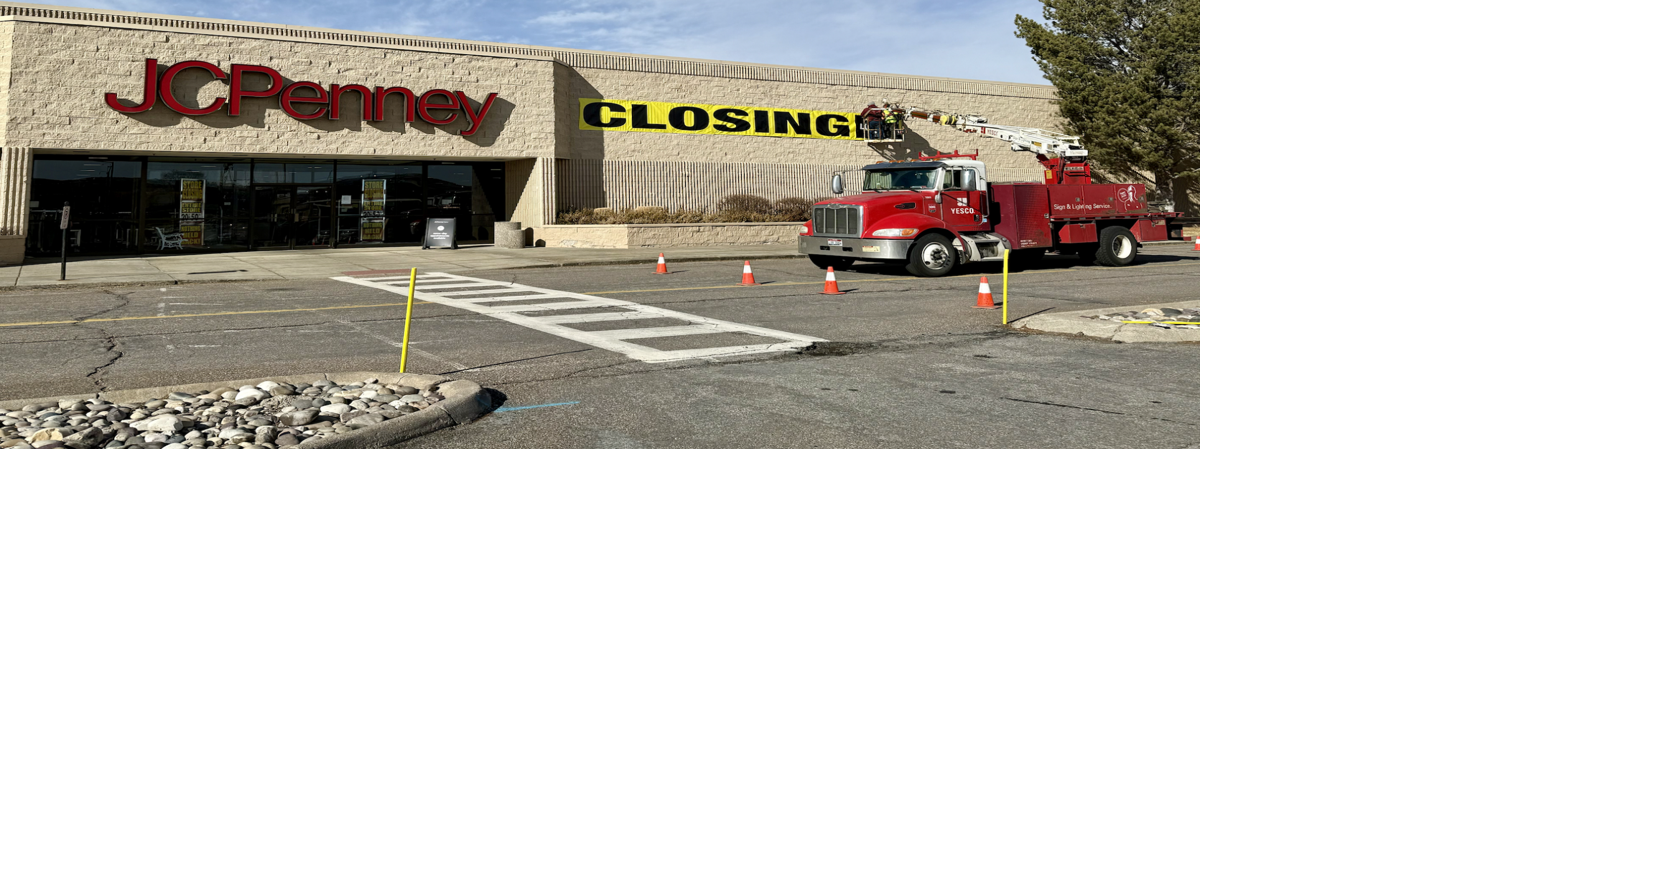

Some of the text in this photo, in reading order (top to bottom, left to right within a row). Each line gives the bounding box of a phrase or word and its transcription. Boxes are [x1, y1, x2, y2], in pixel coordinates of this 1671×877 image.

[104, 58, 498, 136] JCPenney
[183, 180, 202, 189] STORE
[365, 181, 383, 189] STORE
